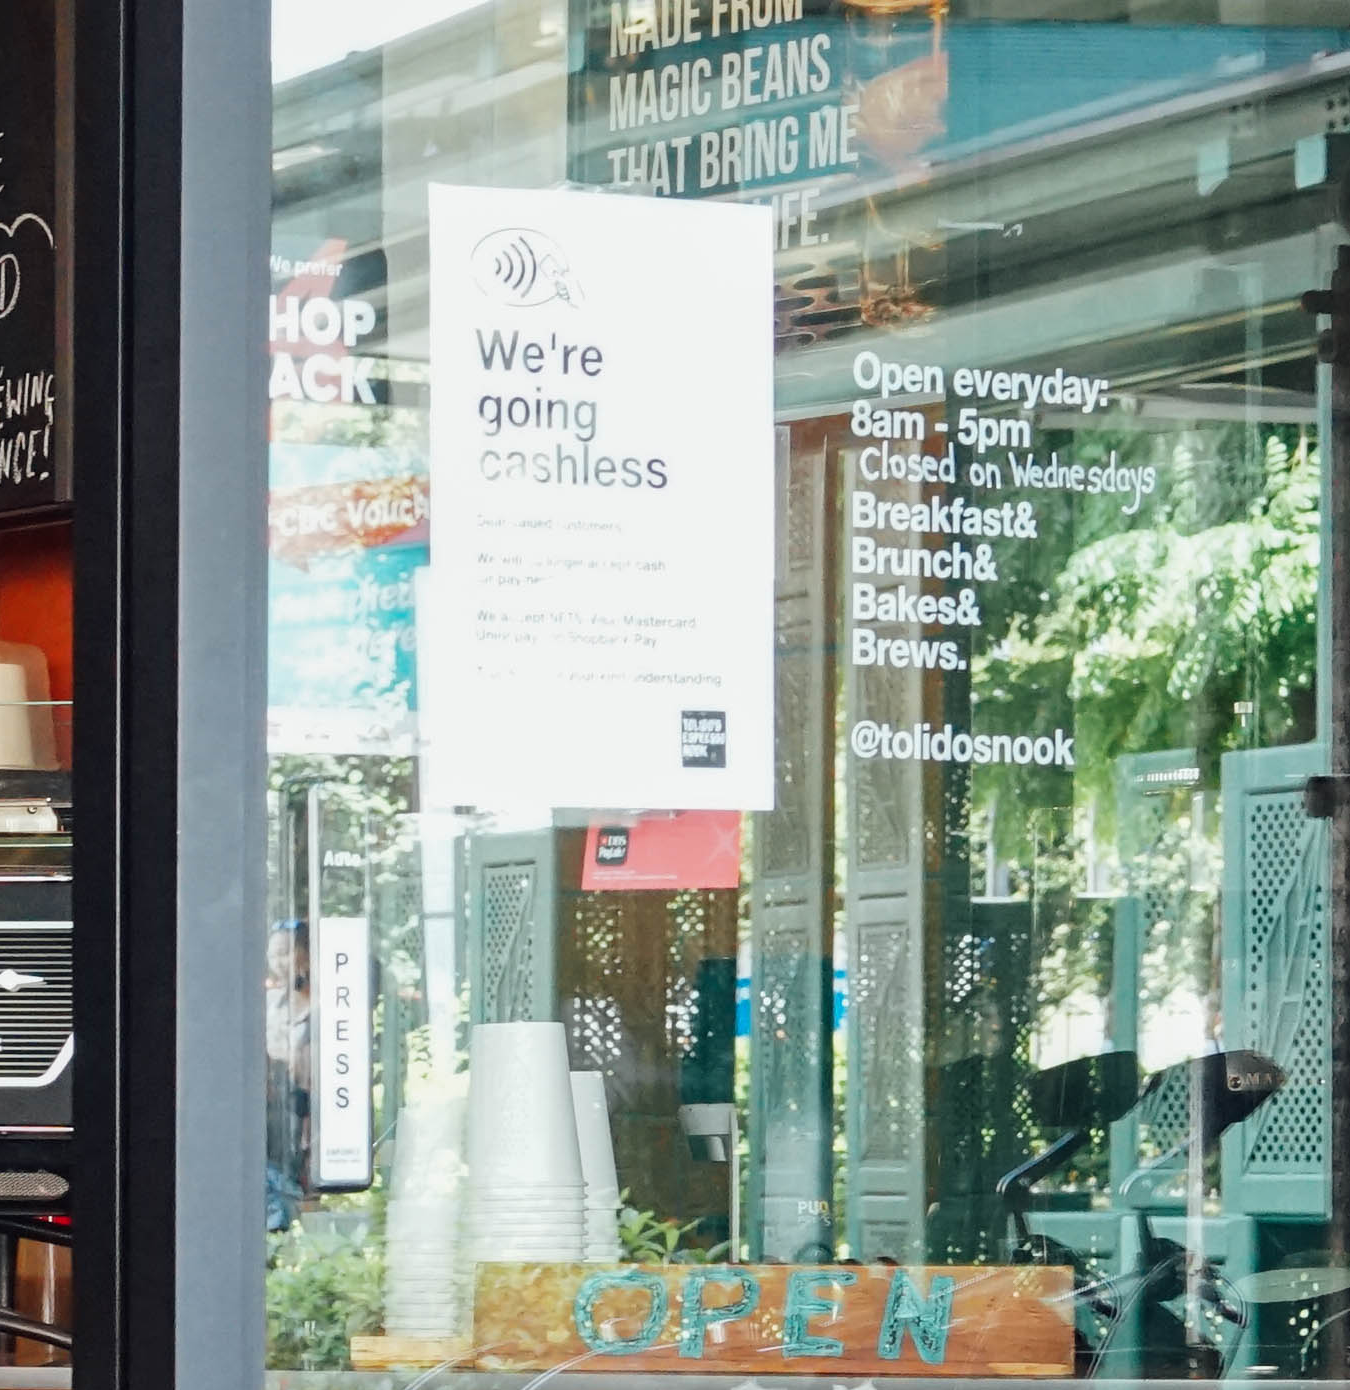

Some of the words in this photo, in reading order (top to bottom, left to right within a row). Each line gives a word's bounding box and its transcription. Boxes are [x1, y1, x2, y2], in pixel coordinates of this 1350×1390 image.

[609, 58, 712, 132] MAGIC
[721, 33, 832, 110] BEANS
[607, 136, 693, 195] THAT
[700, 116, 799, 189] BRING
[808, 104, 860, 169] ME
[476, 328, 604, 378] We're
[853, 351, 944, 399] Open
[953, 367, 1109, 413] everyday:
[477, 385, 597, 442] going
[851, 400, 924, 440] 8am
[958, 408, 1031, 453] 5pm
[479, 443, 669, 490] cashless
[859, 440, 956, 483] Closed
[970, 461, 1002, 489] on
[1008, 450, 1157, 515] Wednesdays
[852, 490, 1038, 538] Breakfast&
[852, 536, 999, 582] Brunch&
[852, 583, 983, 627] Bakes&
[852, 628, 968, 670] Brews.
[851, 720, 1075, 766] @tolidosnook
[335, 953, 350, 1108] PRESS
[573, 1268, 957, 1365] OPEN
